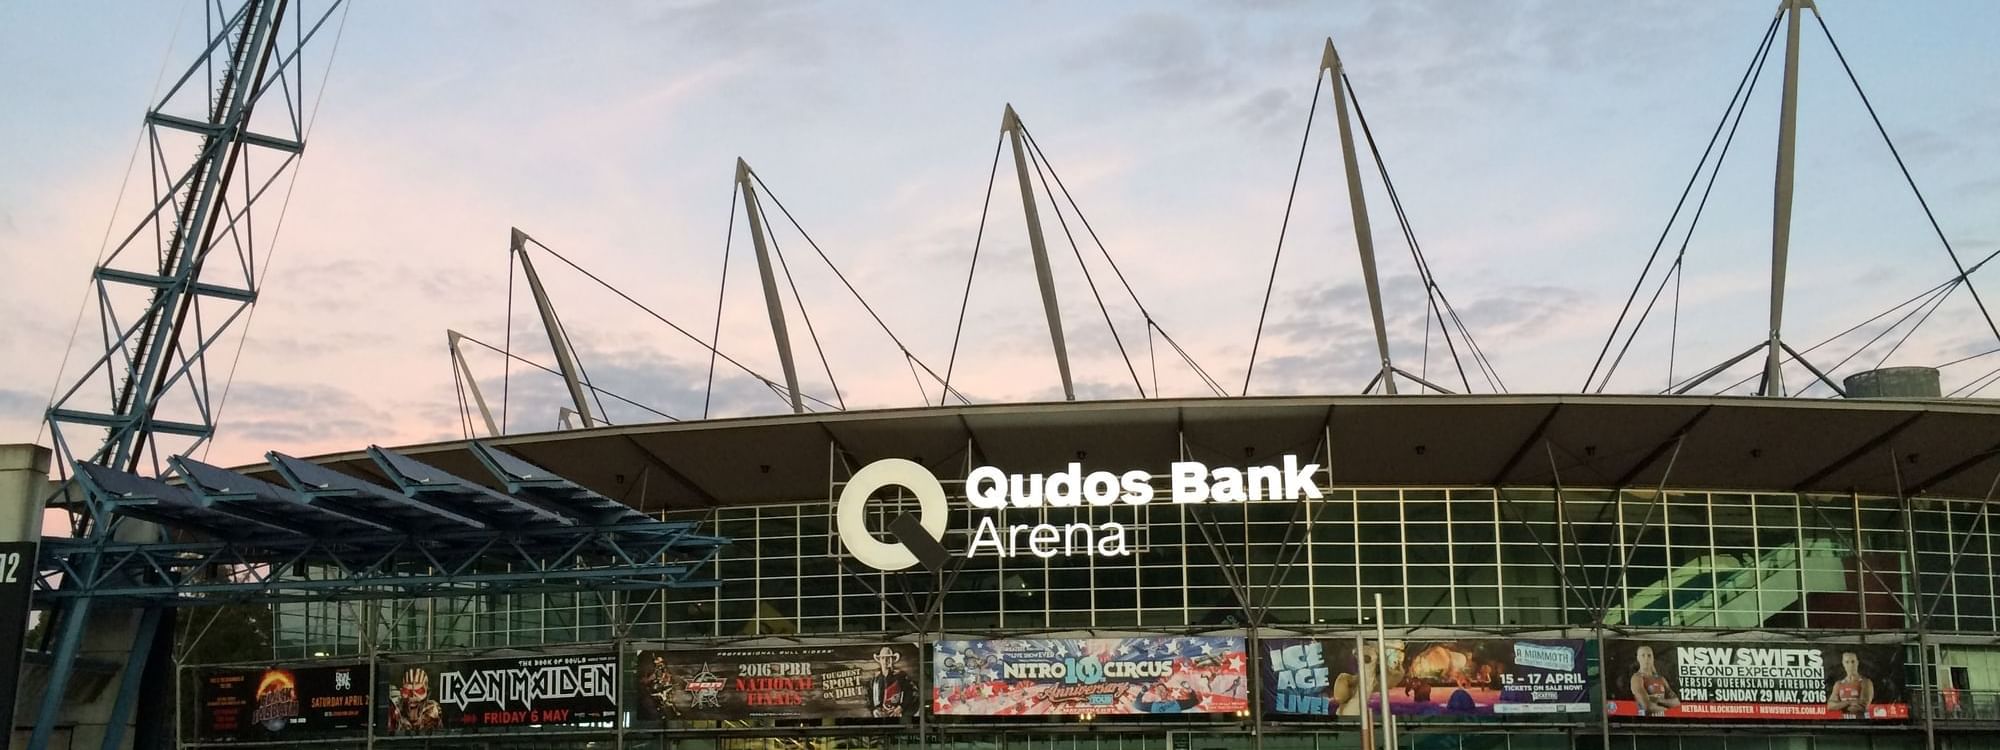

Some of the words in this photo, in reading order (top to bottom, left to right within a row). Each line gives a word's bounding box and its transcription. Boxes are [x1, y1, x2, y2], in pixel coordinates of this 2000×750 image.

[965, 462, 1154, 510] Qudos
[1171, 454, 1324, 503] Bank
[967, 516, 1130, 558] Arena
[1270, 641, 1324, 671] ICE
[1677, 647, 1733, 666] NSW
[1735, 648, 1824, 667] SWIFTS
[739, 664, 771, 677] 2016
[780, 662, 811, 676] PBR
[822, 668, 861, 680] TOUGHEST
[1003, 662, 1066, 679] NITRO
[1065, 655, 1103, 685] 10
[1104, 661, 1173, 678] CIRCUS
[1680, 666, 1734, 676] BEYOND
[1737, 666, 1823, 678] EXPECTATION
[735, 676, 814, 691] NATIONAL
[822, 675, 861, 691] SPORT
[1277, 667, 1330, 690] AGE
[1500, 673, 1514, 684] 15
[1527, 673, 1541, 684] 17
[1545, 673, 1586, 684] APRIL
[1679, 678, 1713, 688] VERSUS
[1716, 678, 1775, 689] QUEENSLAND
[1779, 679, 1826, 689] FIREBIRDS
[440, 670, 506, 712] IRON
[507, 663, 616, 712] MAIDEN
[836, 687, 863, 699] DIRT
[1040, 682, 1130, 702] Anniversary
[311, 696, 343, 708] SATURDAY
[344, 695, 363, 706] APRIL
[746, 691, 803, 706] FINALS
[1679, 688, 1708, 701] 12PM
[1715, 689, 1758, 702] SUNDAY
[1760, 690, 1773, 702] 29
[1775, 690, 1801, 704] MAY,
[1802, 691, 1827, 703] 2016
[1276, 693, 1329, 715] LIVE!
[1681, 704, 1709, 713] NETBALL
[1709, 705, 1754, 714] BLOCKBUSTER
[484, 710, 527, 724] FRIDAY
[530, 709, 539, 722] 6
[543, 709, 569, 721] MAY
